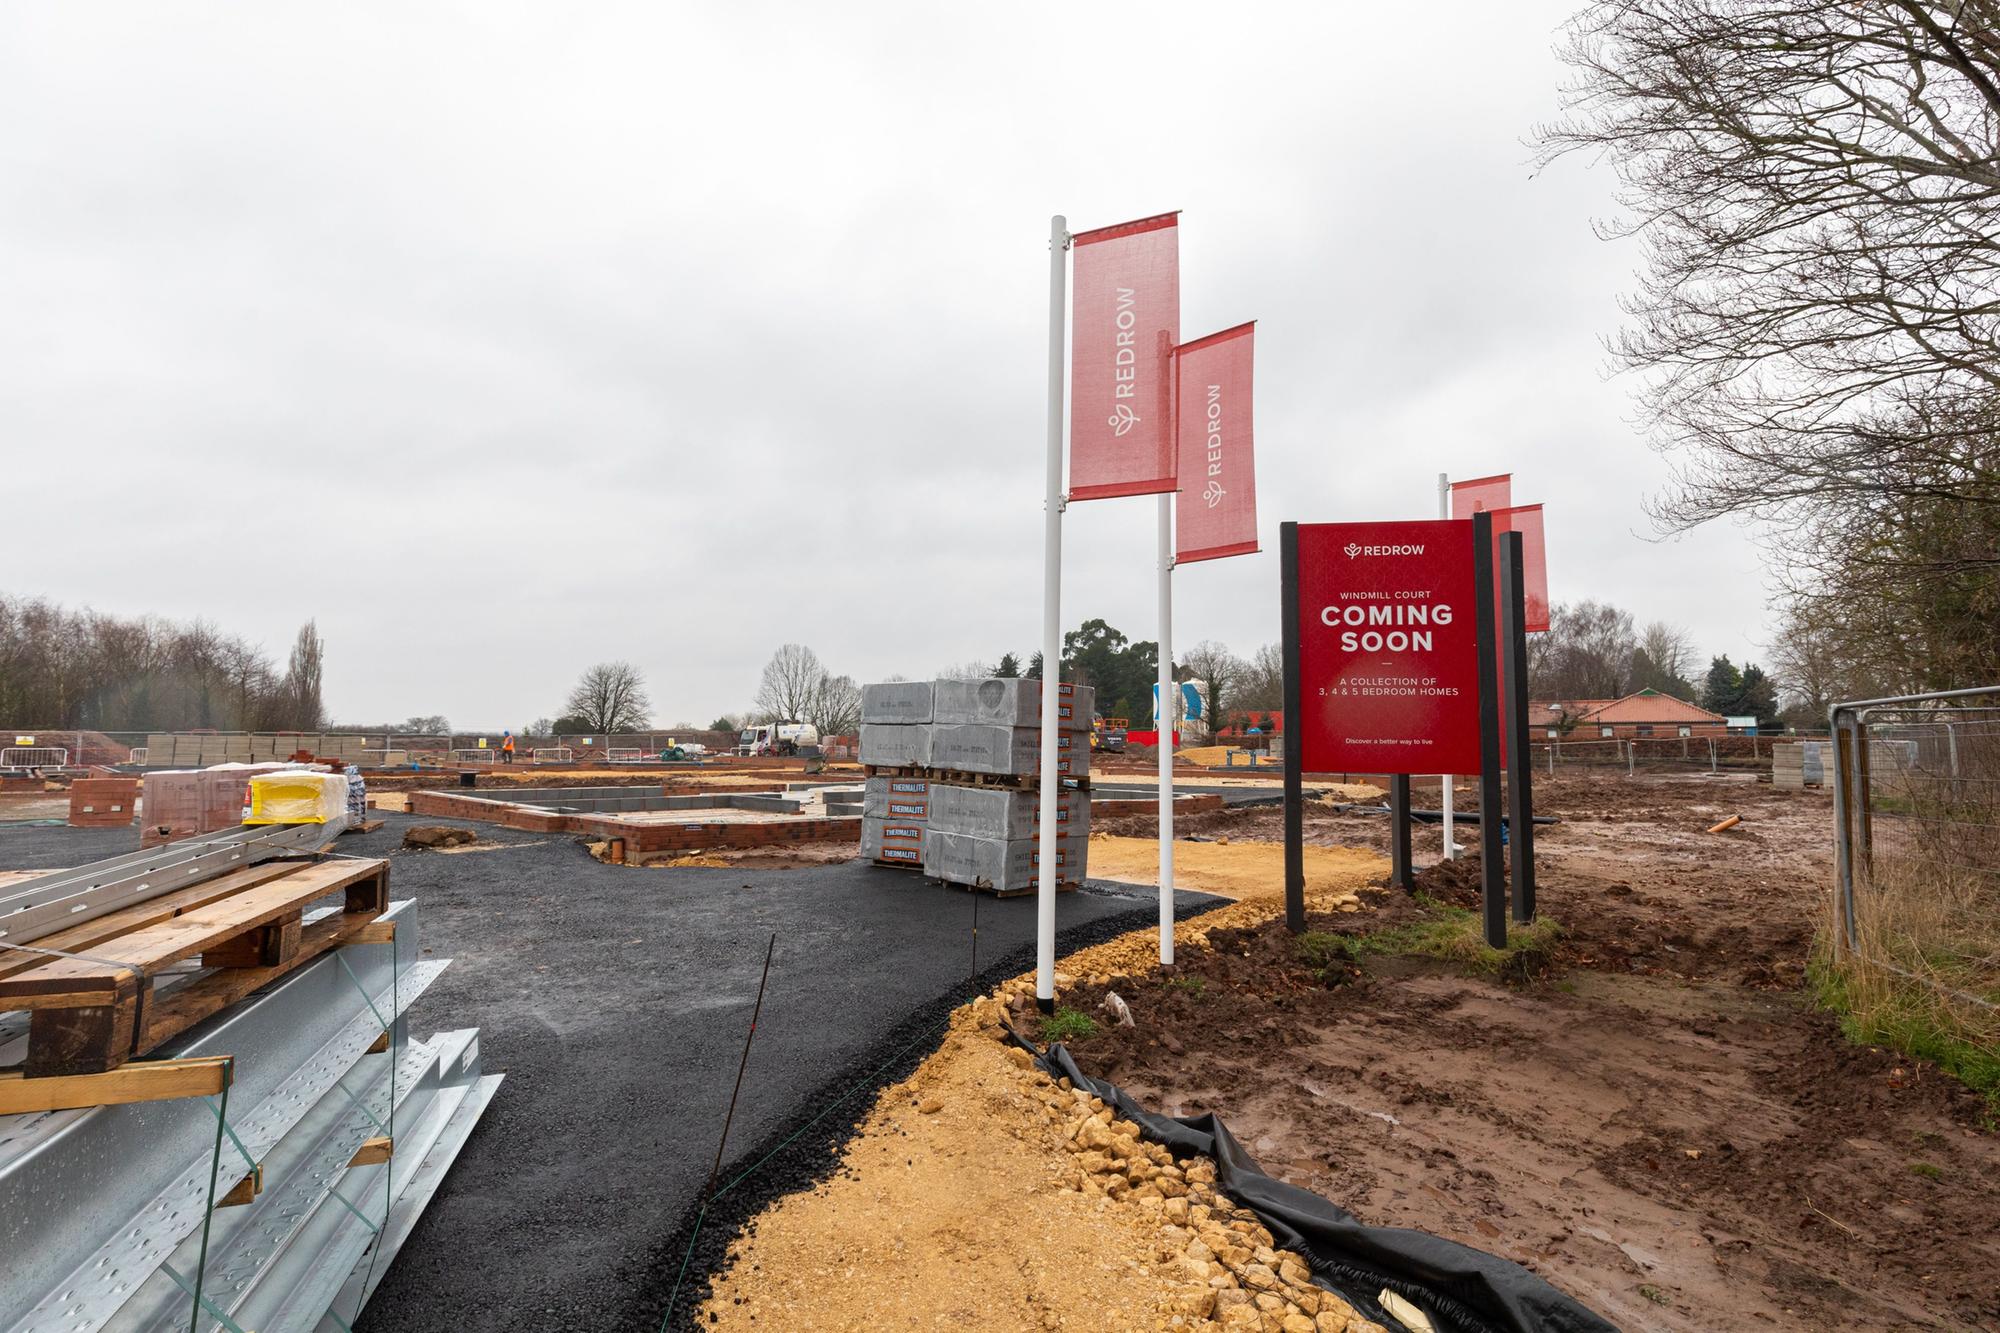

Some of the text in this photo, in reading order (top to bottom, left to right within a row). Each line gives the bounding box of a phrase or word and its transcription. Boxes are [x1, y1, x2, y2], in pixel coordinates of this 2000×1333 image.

[1115, 287, 1136, 399] REDROW
[1207, 384, 1221, 477] REDROW
[1364, 544, 1425, 557] REDROW
[1340, 590, 1431, 600] WINDMILL COURT
[1321, 604, 1453, 626] COMING
[1341, 631, 1432, 652] SOON
[1340, 677, 1437, 686] A COLLECTION OF
[1318, 687, 1459, 696] 3, 4 & 5 BEDROOM HOMES
[892, 783, 926, 792] THERMALITE
[891, 805, 924, 814] THERMALITE
[886, 829, 918, 838] THERMALITE
[884, 849, 917, 859] THERMALITE
